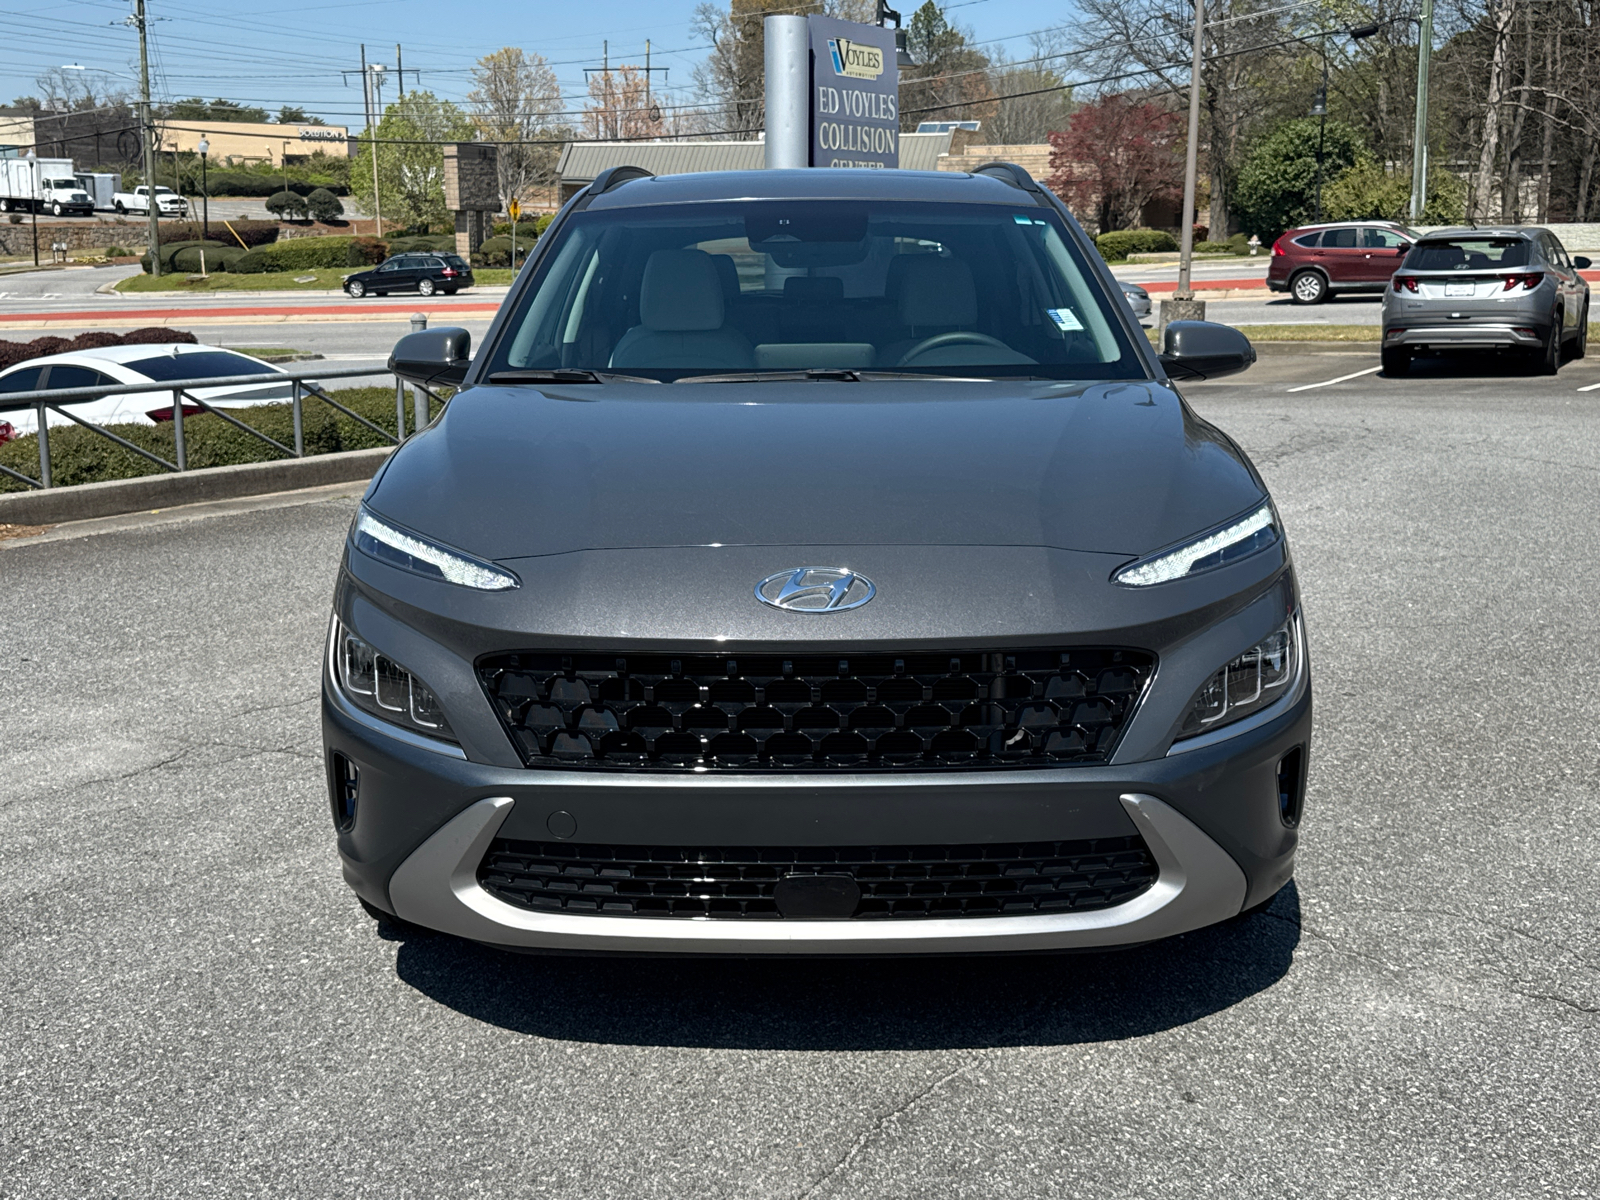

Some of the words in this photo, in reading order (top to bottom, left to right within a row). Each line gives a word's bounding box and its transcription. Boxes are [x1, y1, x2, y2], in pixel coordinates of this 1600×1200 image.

[835, 39, 880, 71] VOYLES
[846, 71, 876, 79] AUTOMOTIVE
[819, 86, 839, 114] ED
[842, 90, 896, 120] VOYLES
[819, 122, 896, 154] COLLISION
